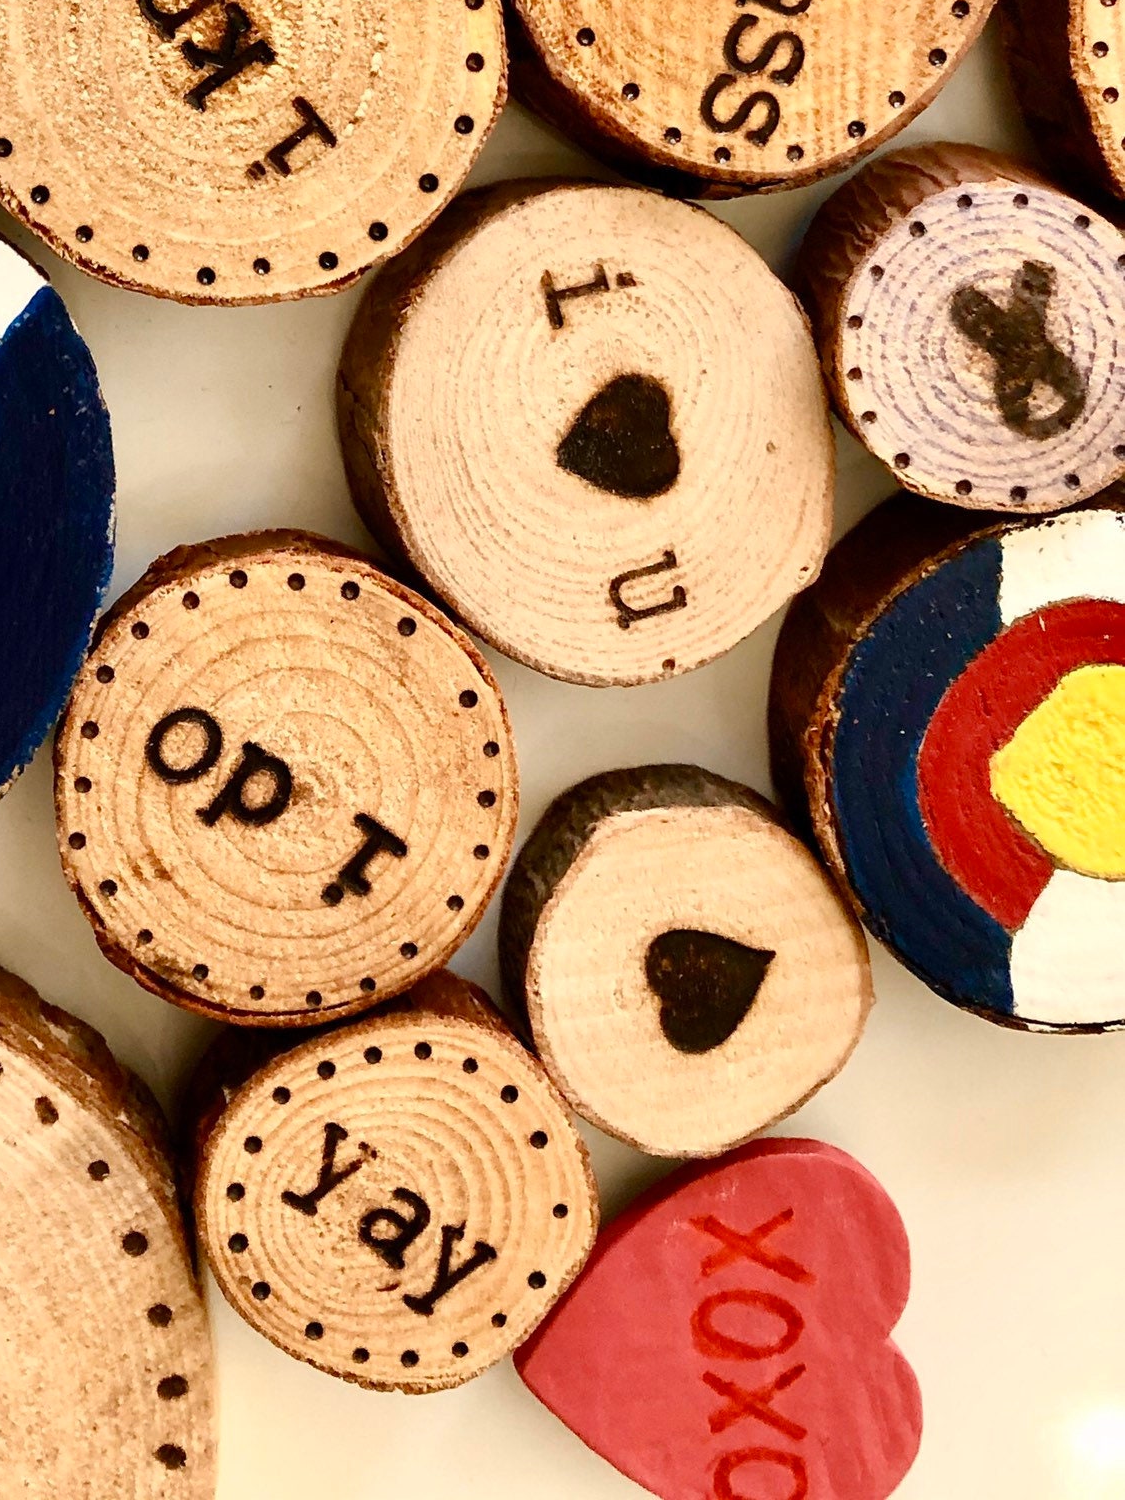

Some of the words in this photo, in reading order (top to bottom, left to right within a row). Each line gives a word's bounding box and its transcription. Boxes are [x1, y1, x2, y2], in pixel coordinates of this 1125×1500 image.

[144, 706, 294, 827] do
[281, 1121, 498, 1317] yay
[688, 1206, 816, 1500] XOXO
